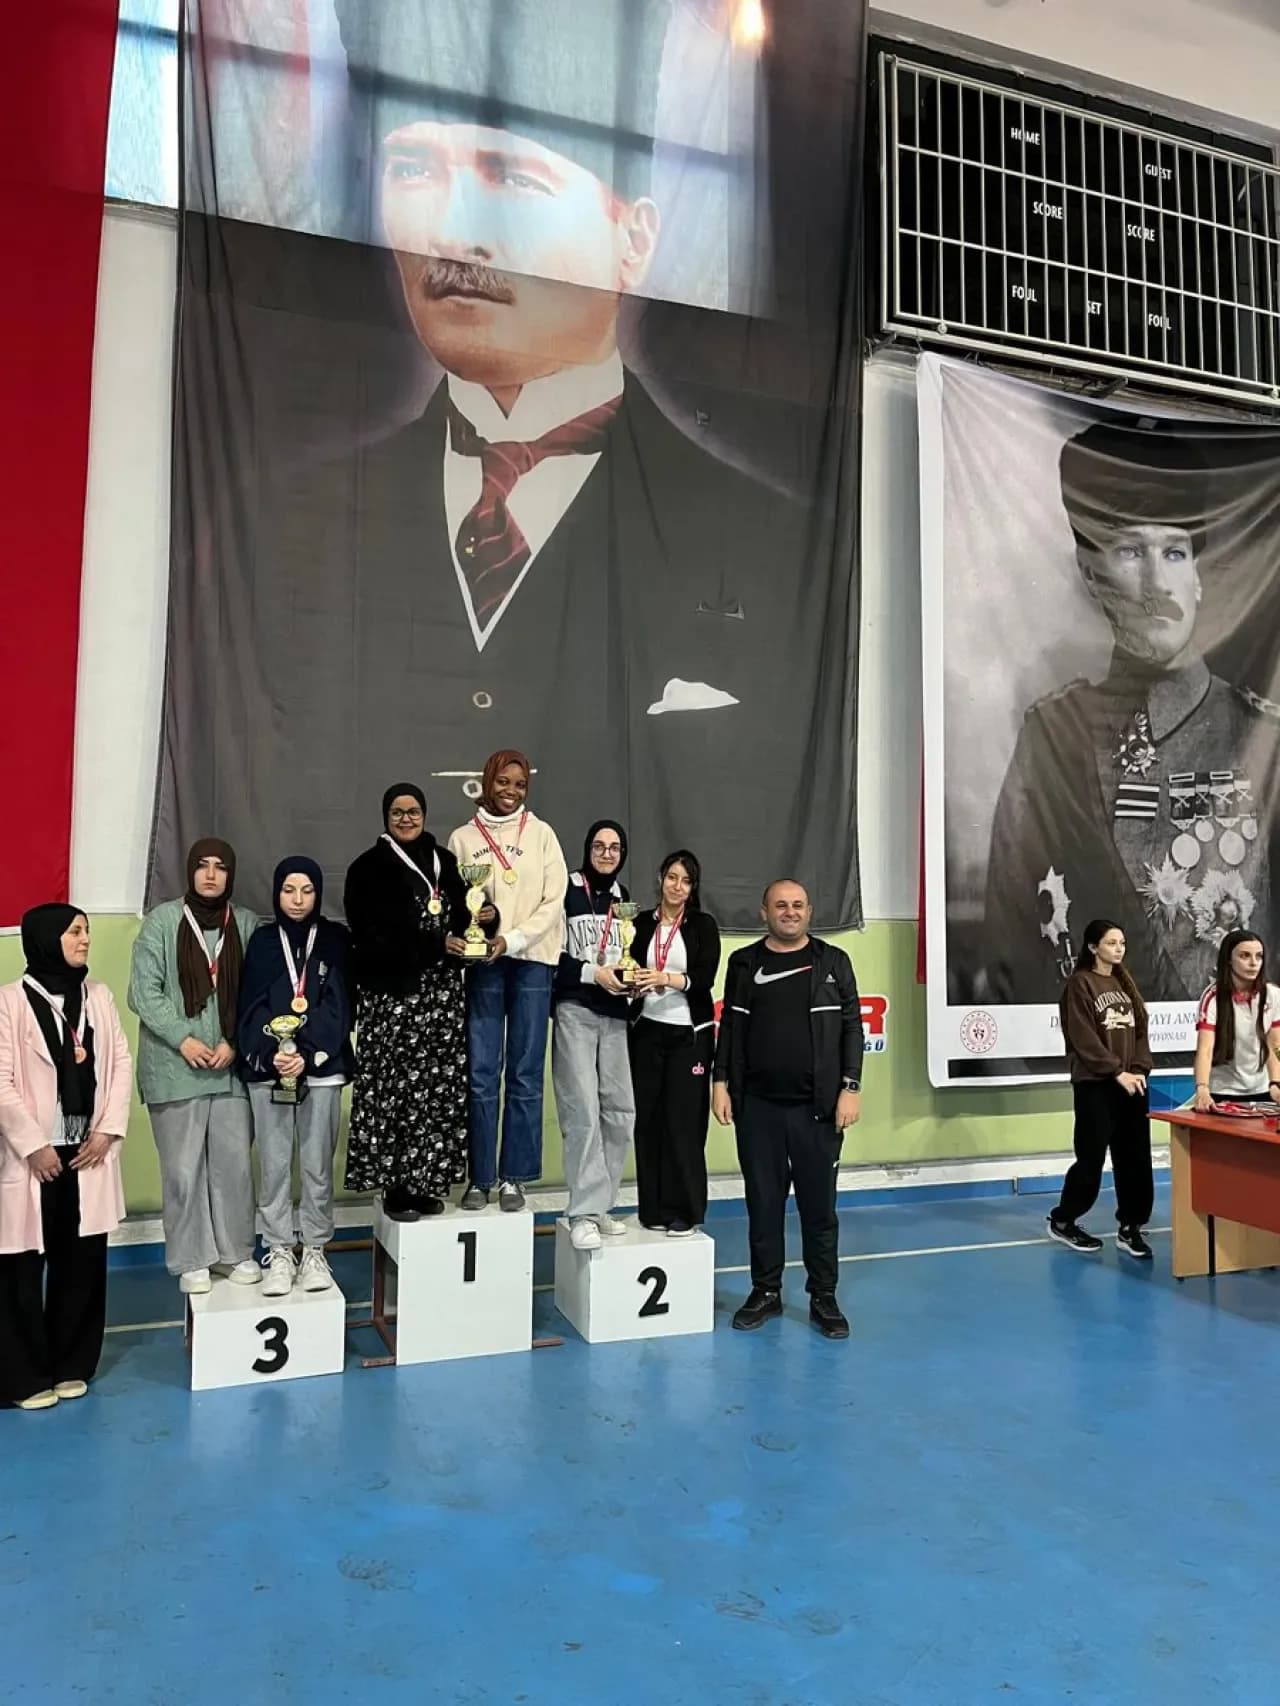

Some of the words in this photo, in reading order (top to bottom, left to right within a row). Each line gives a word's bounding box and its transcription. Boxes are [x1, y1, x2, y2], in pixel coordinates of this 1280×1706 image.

[1010, 127, 1041, 146] HOME
[1144, 163, 1173, 180] GUEST
[1033, 201, 1064, 220] SCORE
[1127, 224, 1155, 242] SCORE
[1011, 284, 1038, 302] FOUL
[1149, 1013, 1171, 1025] AYI
[458, 1232, 476, 1282] 1
[638, 1267, 669, 1317] 2
[252, 1317, 289, 1373] 3
